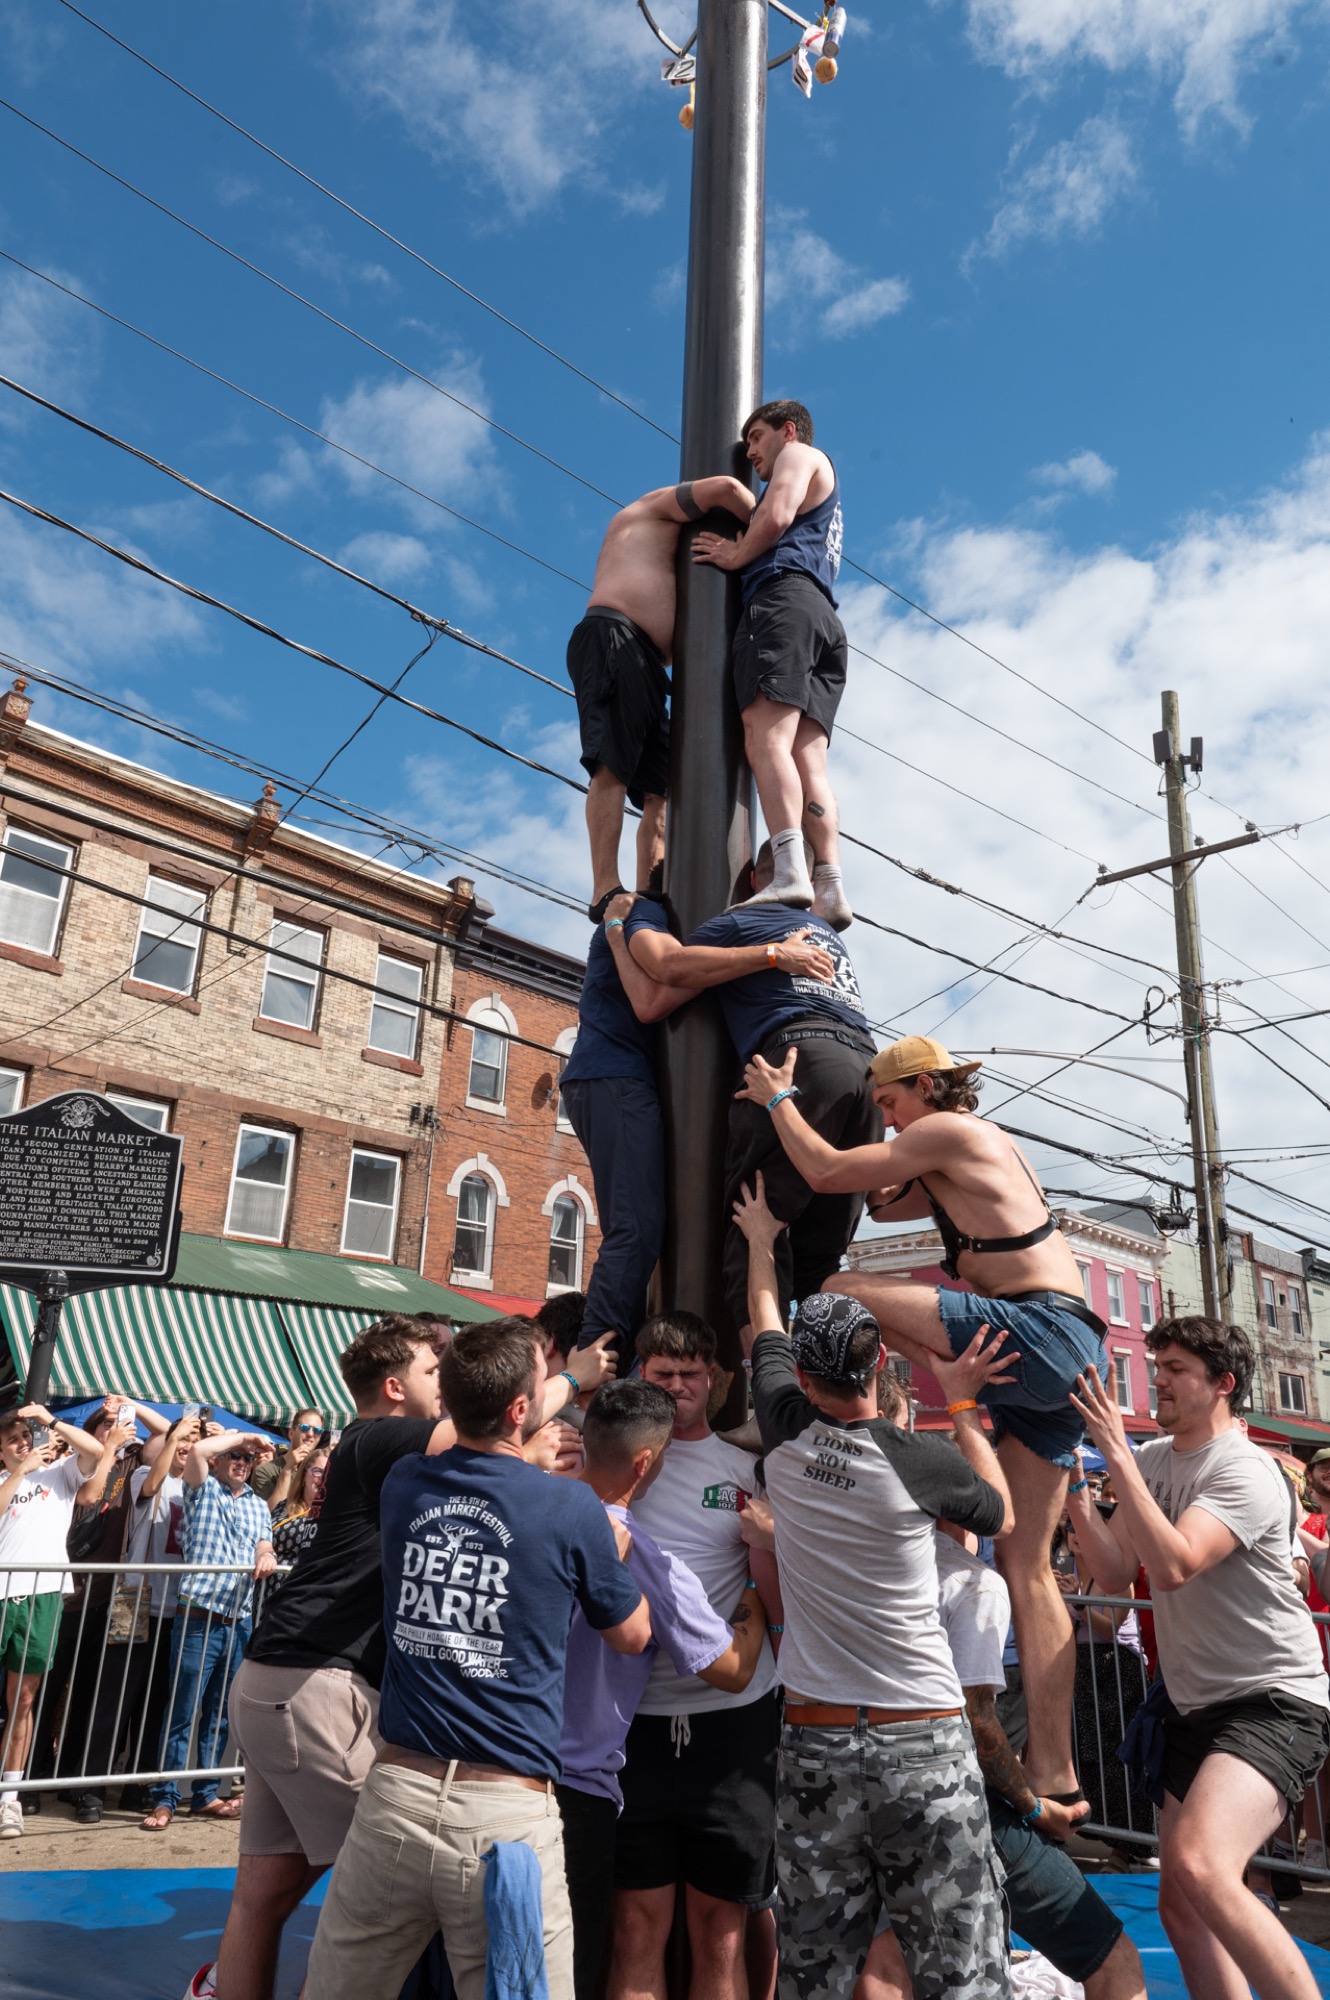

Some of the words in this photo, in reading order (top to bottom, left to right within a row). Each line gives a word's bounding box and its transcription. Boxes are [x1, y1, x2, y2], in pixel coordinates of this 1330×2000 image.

[664, 60, 694, 80] 12
[34, 1126, 90, 1141] ITALIAN
[25, 1140, 59, 1148] SECOND
[64, 1144, 120, 1153] GENERATION
[30, 1149, 80, 1158] ORGANIZED
[95, 1154, 133, 1163] BUSINESS
[41, 1158, 89, 1167] COMPETING
[94, 1162, 126, 1170] NEARBY
[52, 1175, 91, 1183] SOUTHERN
[93, 1170, 138, 1179] ANCESTRIES
[6, 1187, 51, 1196] NORTHERN
[32, 1181, 71, 1190] MEMBERS
[123, 1188, 166, 1197] AMERICANS
[28, 1205, 57, 1213] ALWAYS
[24, 1222, 90, 1232] MANUFACTURERS
[813, 1435, 863, 1457] LIONS
[815, 1452, 851, 1472] NOT
[803, 1465, 856, 1491] SHEEP
[449, 1496, 460, 1504] THE
[408, 1506, 441, 1534] ITALIAN
[443, 1504, 480, 1519] MARKET
[479, 1510, 514, 1549] FESTIVAL
[425, 1534, 443, 1545] EST.
[465, 1541, 484, 1551] 1873
[402, 1541, 510, 1595] DEER
[396, 1580, 508, 1635] PARK
[408, 1627, 426, 1639] PHILLY
[426, 1630, 452, 1643] HOAGIE
[454, 1635, 463, 1645] OF
[466, 1637, 479, 1647] THE
[414, 1643, 436, 1659] STILL
[438, 1647, 466, 1664] GOOD
